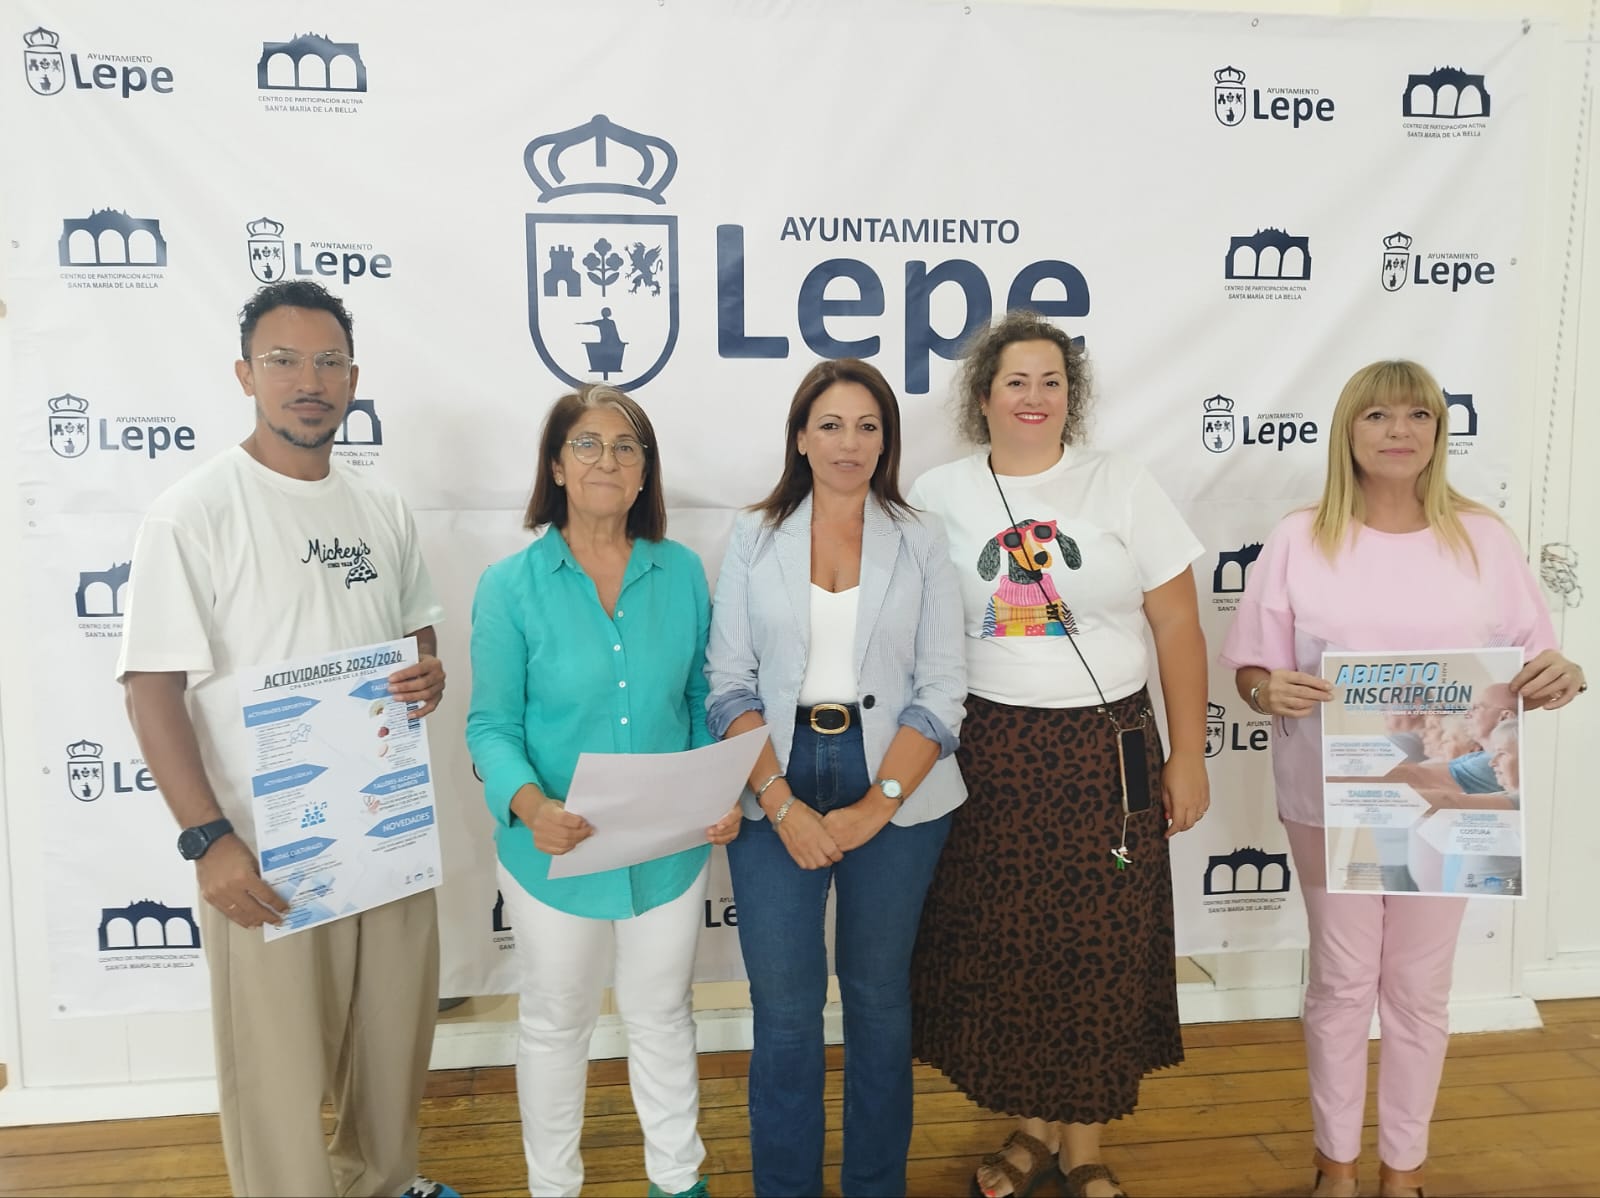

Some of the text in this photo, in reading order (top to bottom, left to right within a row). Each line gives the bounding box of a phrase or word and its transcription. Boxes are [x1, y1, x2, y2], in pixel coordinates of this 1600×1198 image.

[87, 52, 152, 63] AYUNTAMIENTO
[70, 53, 173, 98] Lepe
[1267, 87, 1319, 95] AYUNTAMIENTO
[1253, 89, 1335, 128] Lepe
[780, 216, 1020, 244] AYUNTAMIENTO
[310, 241, 372, 250] AYUNTAMIENTO
[294, 242, 392, 284] Lepe
[1414, 255, 1494, 292] Lepe
[716, 224, 1091, 395] Lepe
[99, 418, 195, 459] Lepe
[1242, 415, 1318, 451] Lepe
[301, 537, 371, 565] Mickey's
[263, 650, 402, 689] ACTIVIDADES 2025/2026
[1336, 662, 1439, 687] ABIERTO
[303, 680, 322, 688] SANTA
[1344, 680, 1472, 704] INSCRIPCIÓN
[1232, 723, 1268, 751] Le
[113, 762, 157, 793] Le
[383, 812, 430, 833] NOVEDADES
[705, 900, 739, 928] Le
